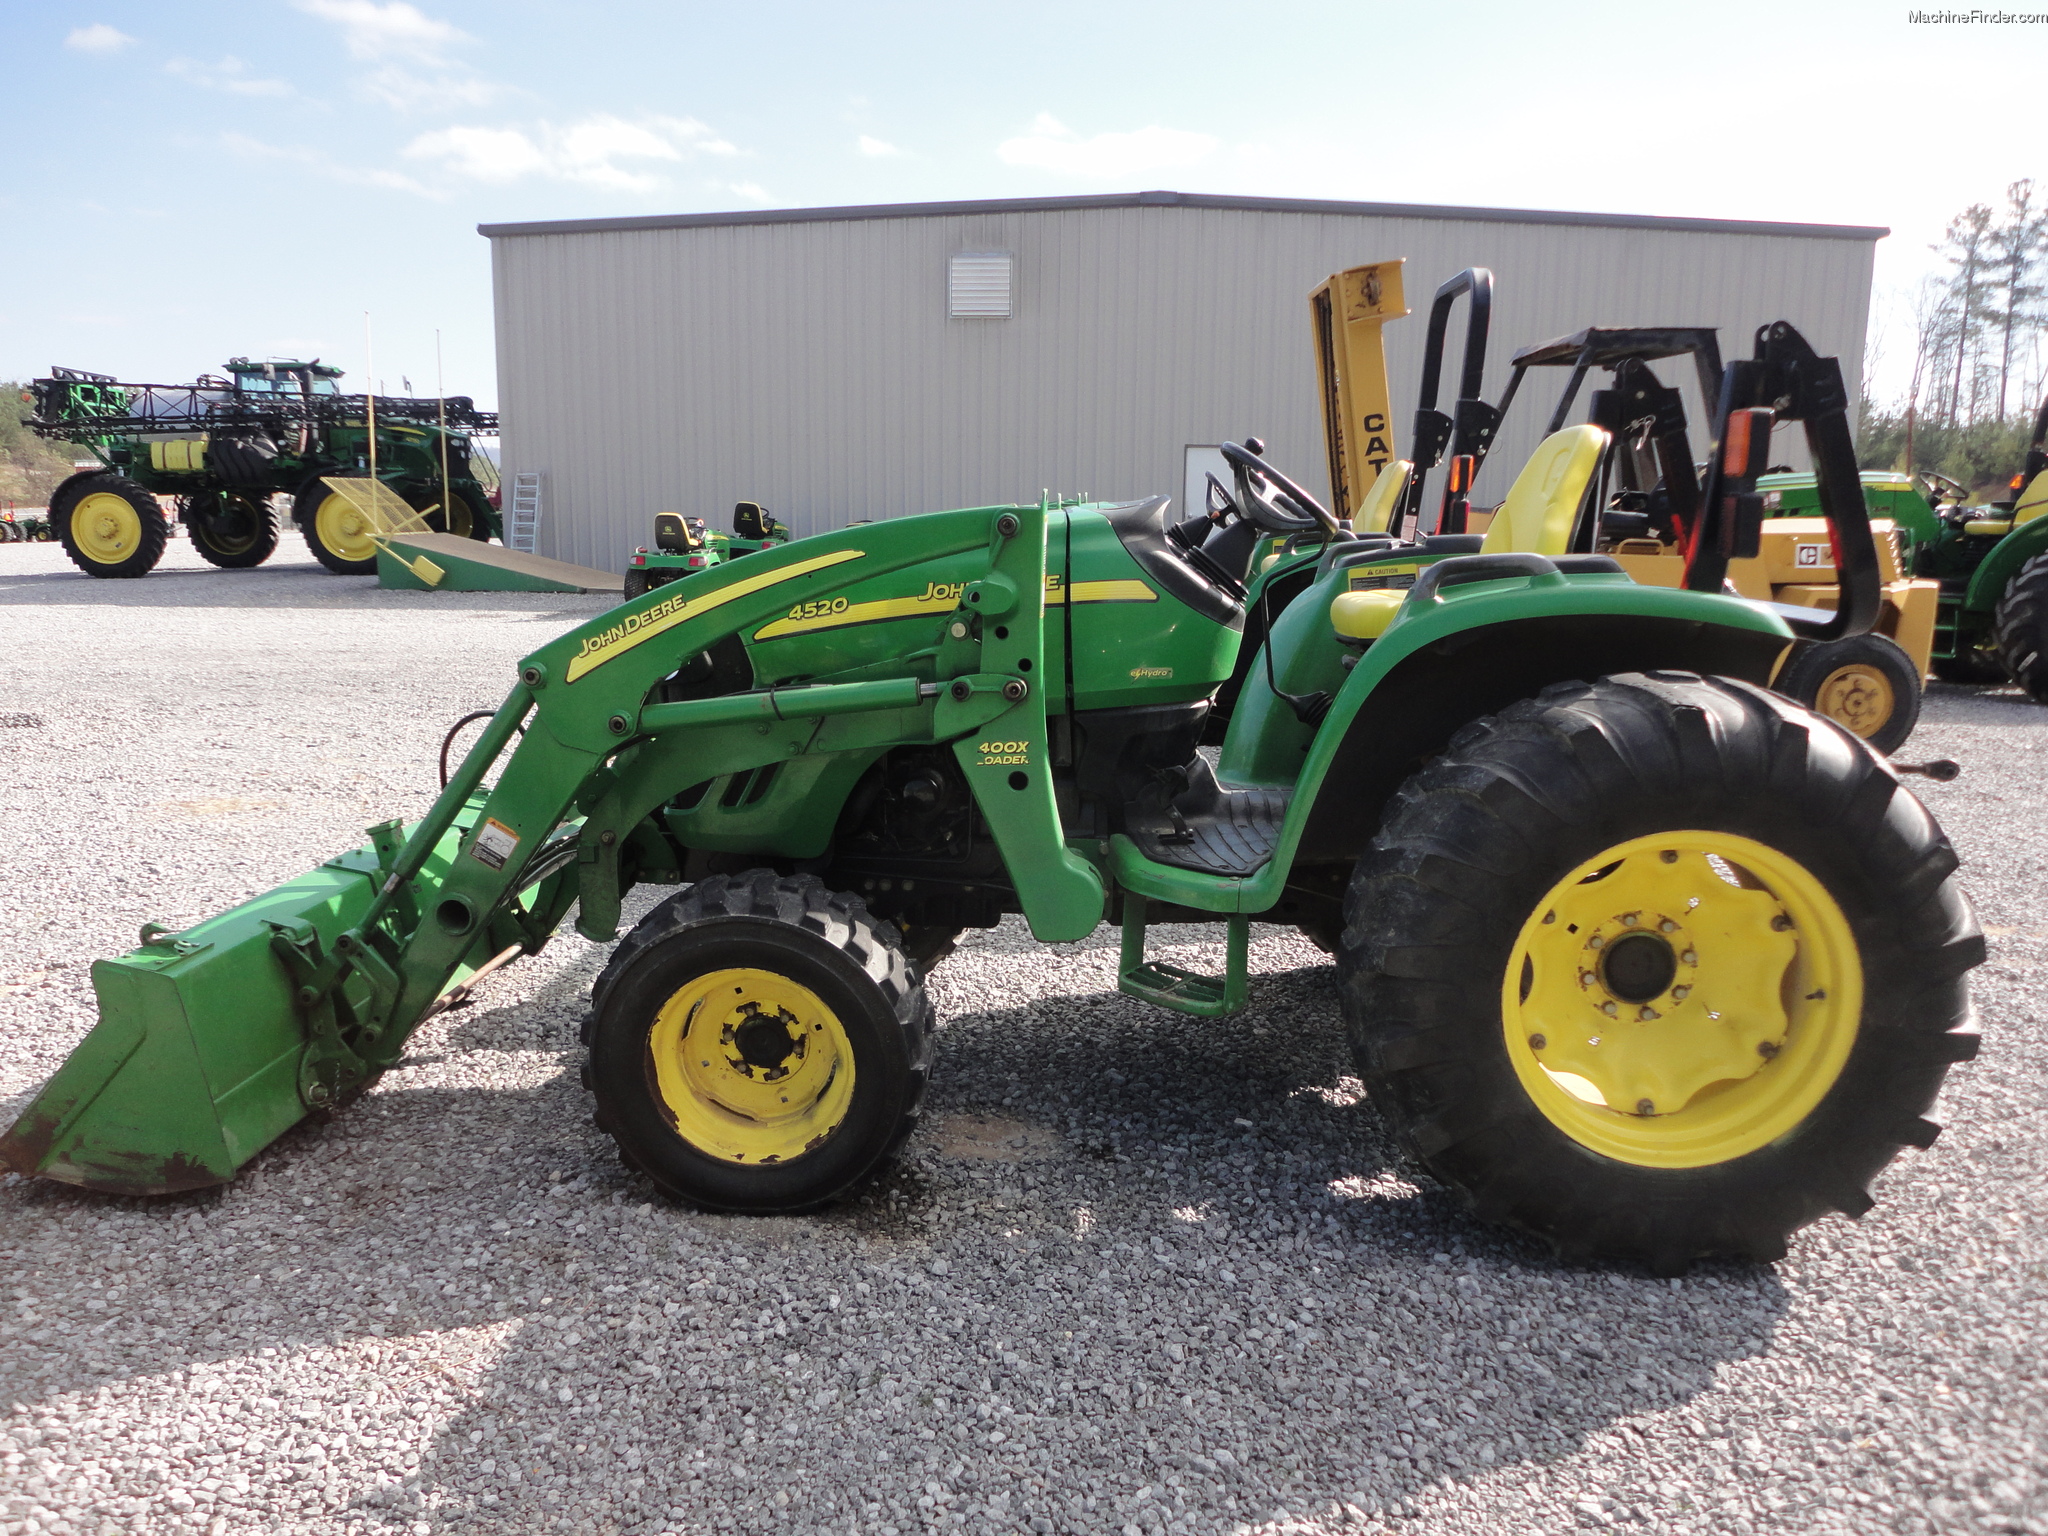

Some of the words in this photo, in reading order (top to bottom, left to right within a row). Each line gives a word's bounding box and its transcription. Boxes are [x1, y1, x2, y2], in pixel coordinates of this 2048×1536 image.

[1363, 413, 1390, 478] CAT
[917, 581, 972, 601] JOH
[786, 596, 849, 620] 4520
[577, 625, 626, 659] JOHN
[623, 593, 687, 634] DEERE
[978, 740, 1030, 754] 400X
